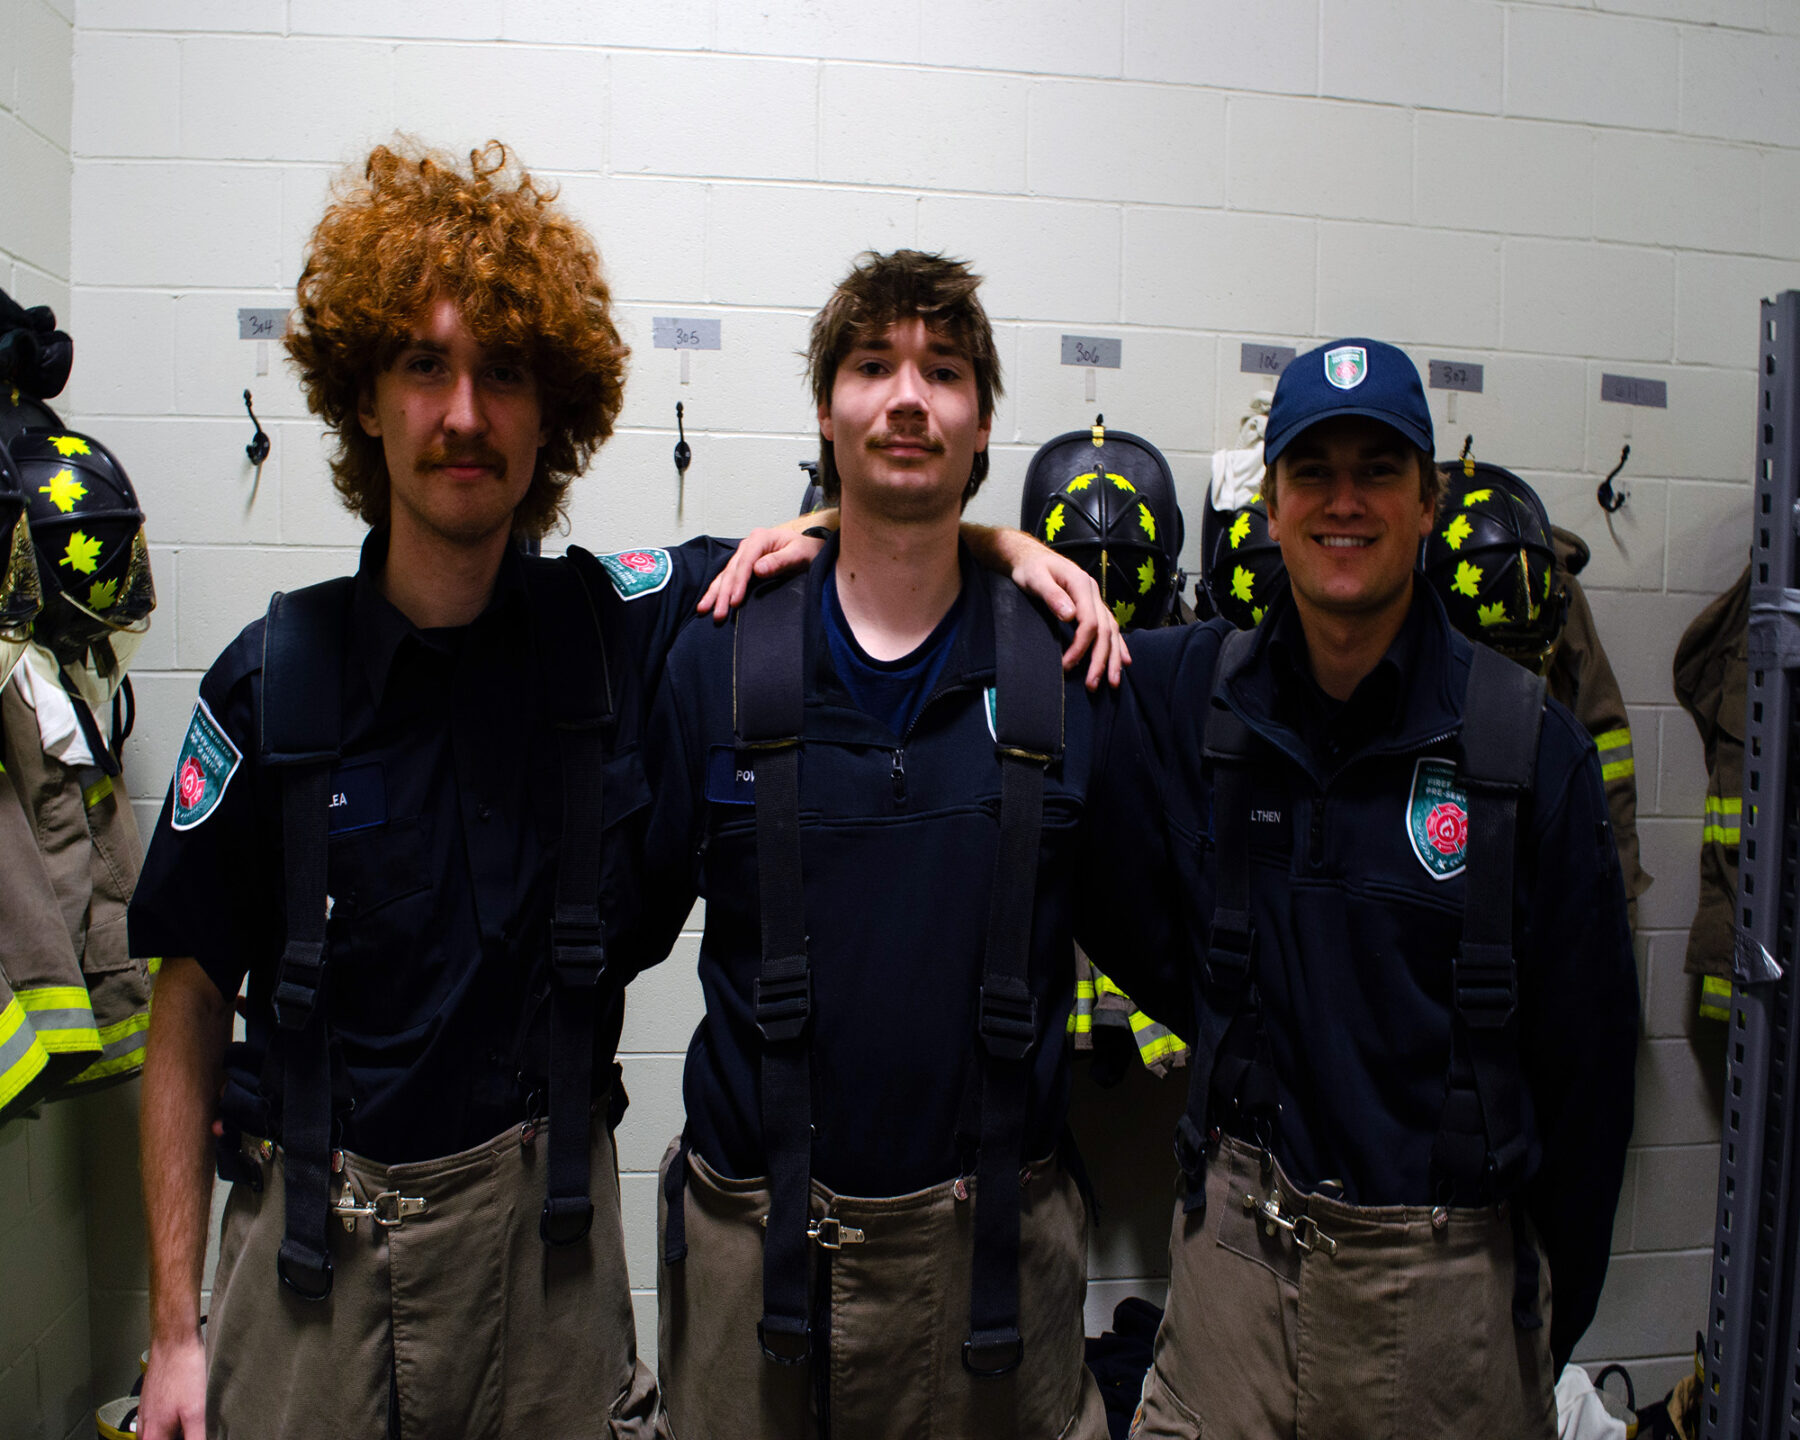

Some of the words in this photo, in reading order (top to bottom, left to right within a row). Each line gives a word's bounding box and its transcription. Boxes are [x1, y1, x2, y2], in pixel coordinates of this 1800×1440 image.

[675, 327, 701, 345] 305
[1075, 341, 1100, 364] 306
[1259, 351, 1280, 370] 106
